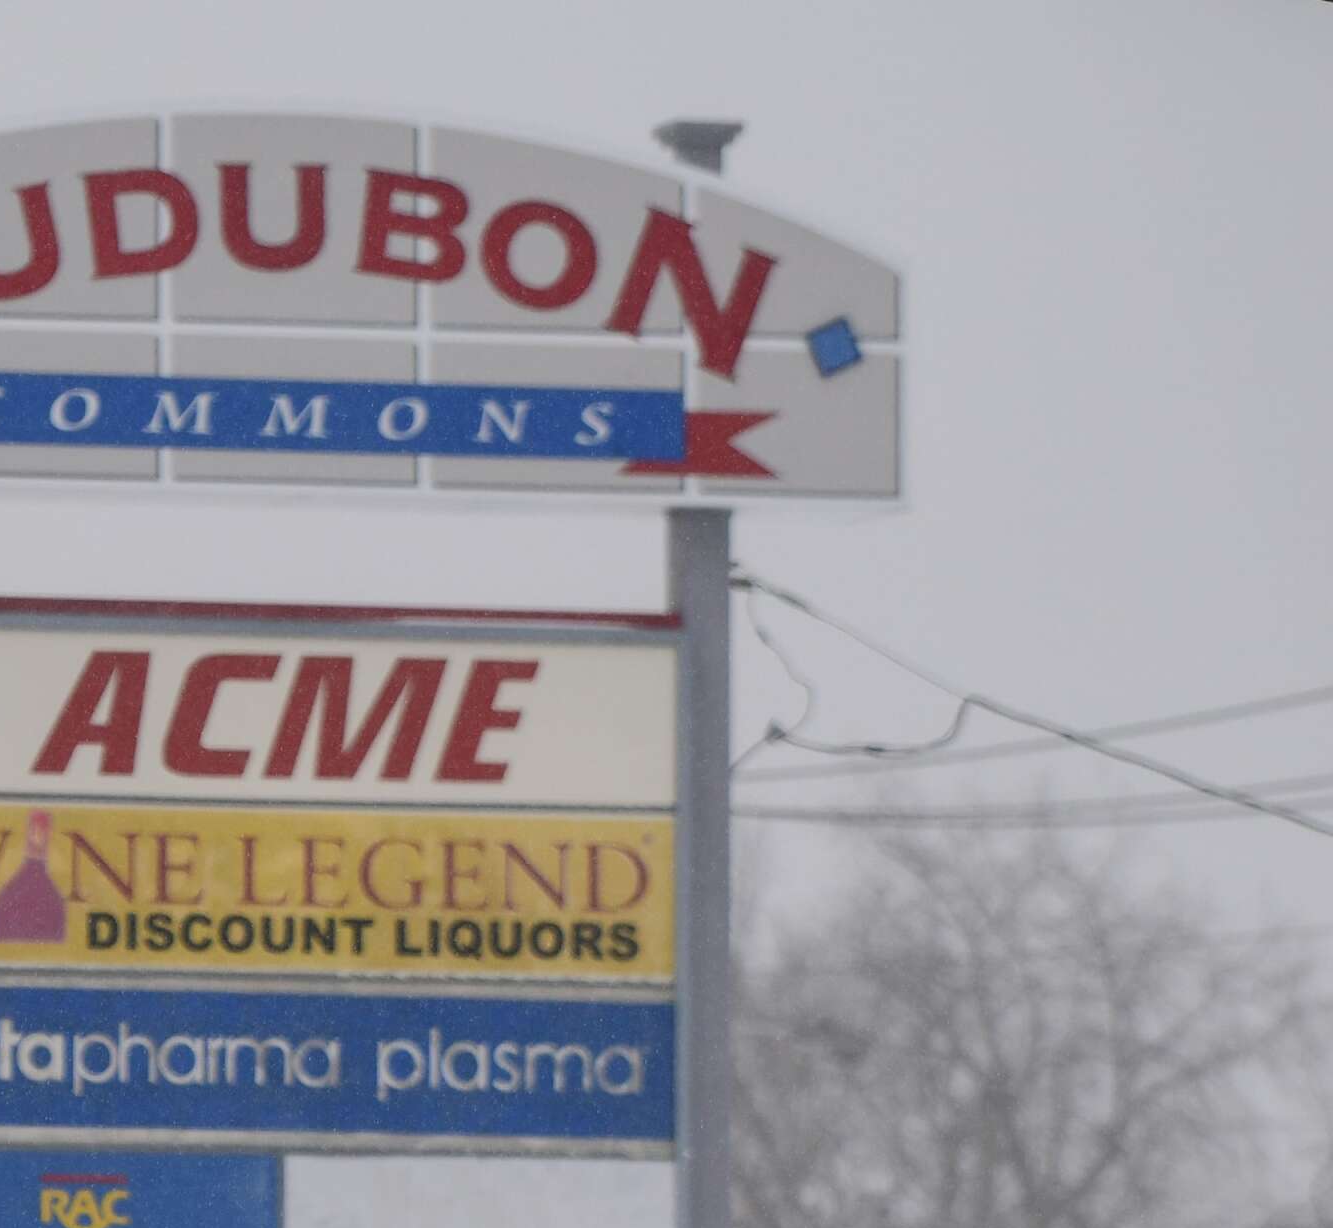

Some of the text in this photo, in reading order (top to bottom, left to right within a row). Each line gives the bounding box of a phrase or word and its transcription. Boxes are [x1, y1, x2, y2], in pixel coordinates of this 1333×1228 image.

[30, 650, 540, 784] ACME
[237, 833, 652, 915] LEGEND
[85, 911, 641, 963] DISCOUNT LIQUORS
[375, 1027, 646, 1102] plasma
